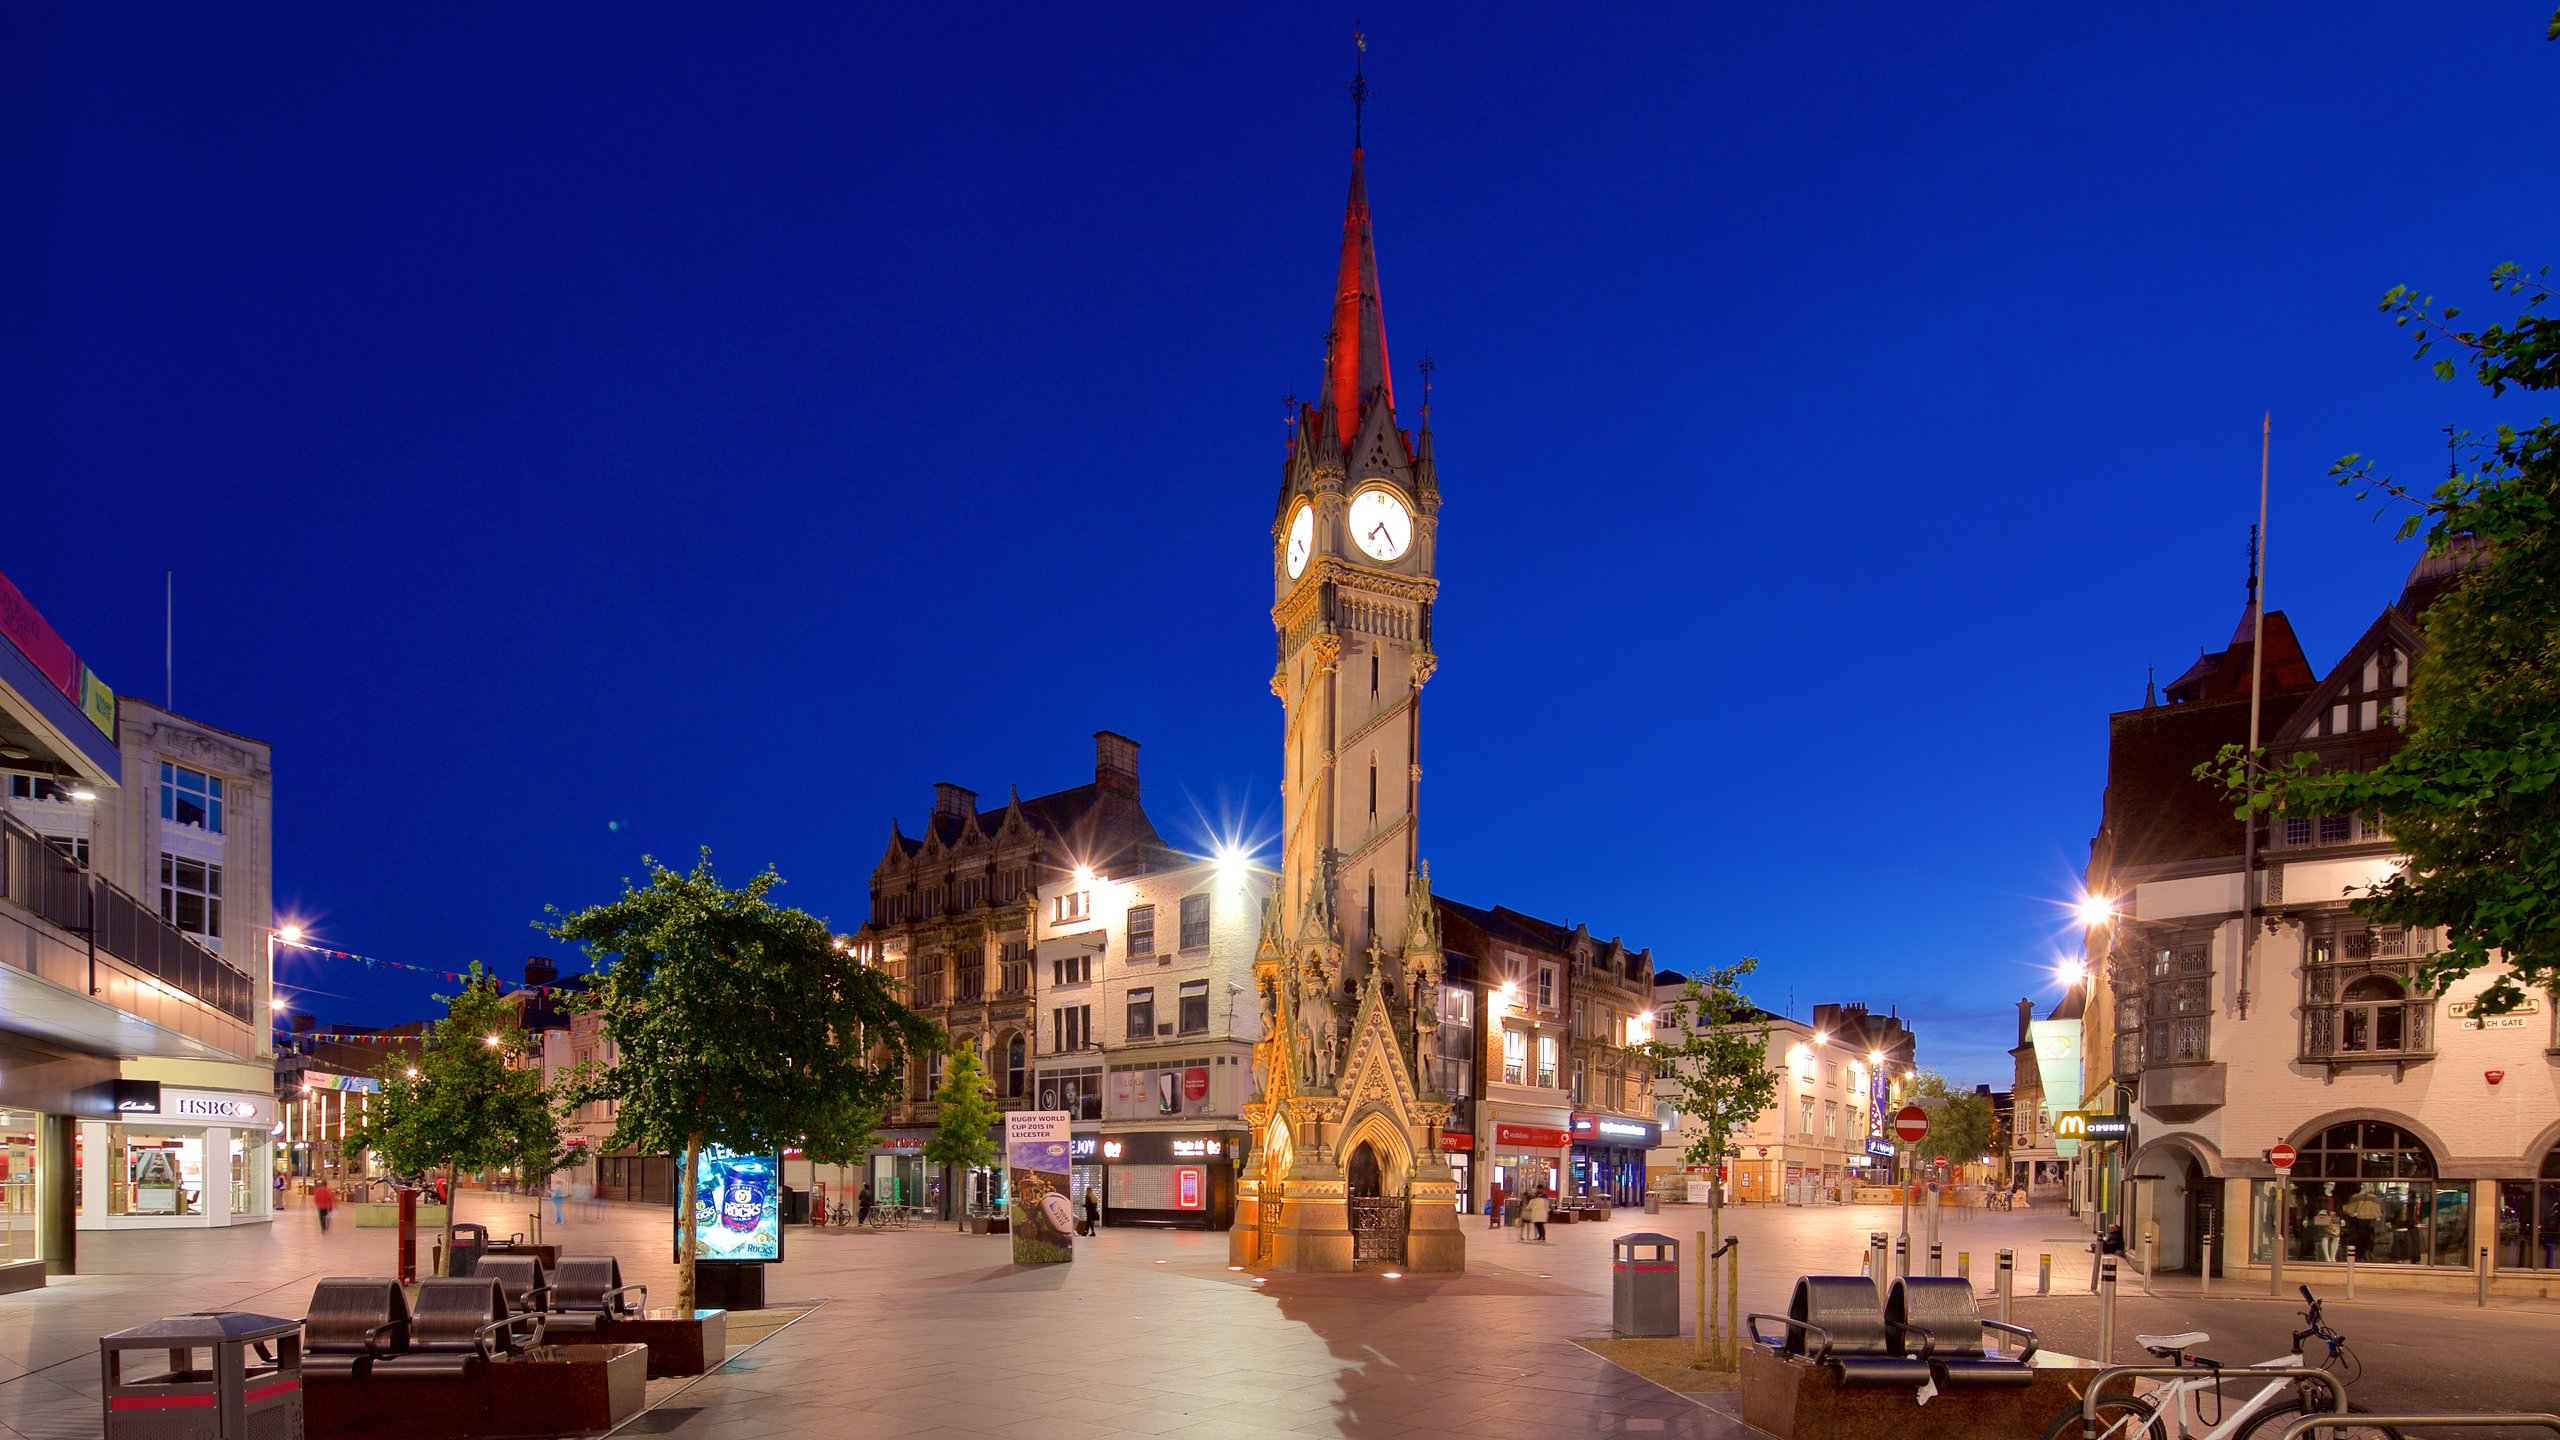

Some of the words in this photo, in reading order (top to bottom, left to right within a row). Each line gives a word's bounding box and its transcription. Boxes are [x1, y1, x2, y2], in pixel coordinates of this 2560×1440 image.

[2502, 1019, 2523, 1027] GATE
[180, 1100, 233, 1116] HSBC
[2087, 1124, 2125, 1132] CRUISE
[696, 1206, 715, 1220] OCKS
[725, 1202, 761, 1218] ROCKS
[1054, 1212, 1065, 1226] 2015
[747, 1243, 773, 1255] ROCKS
